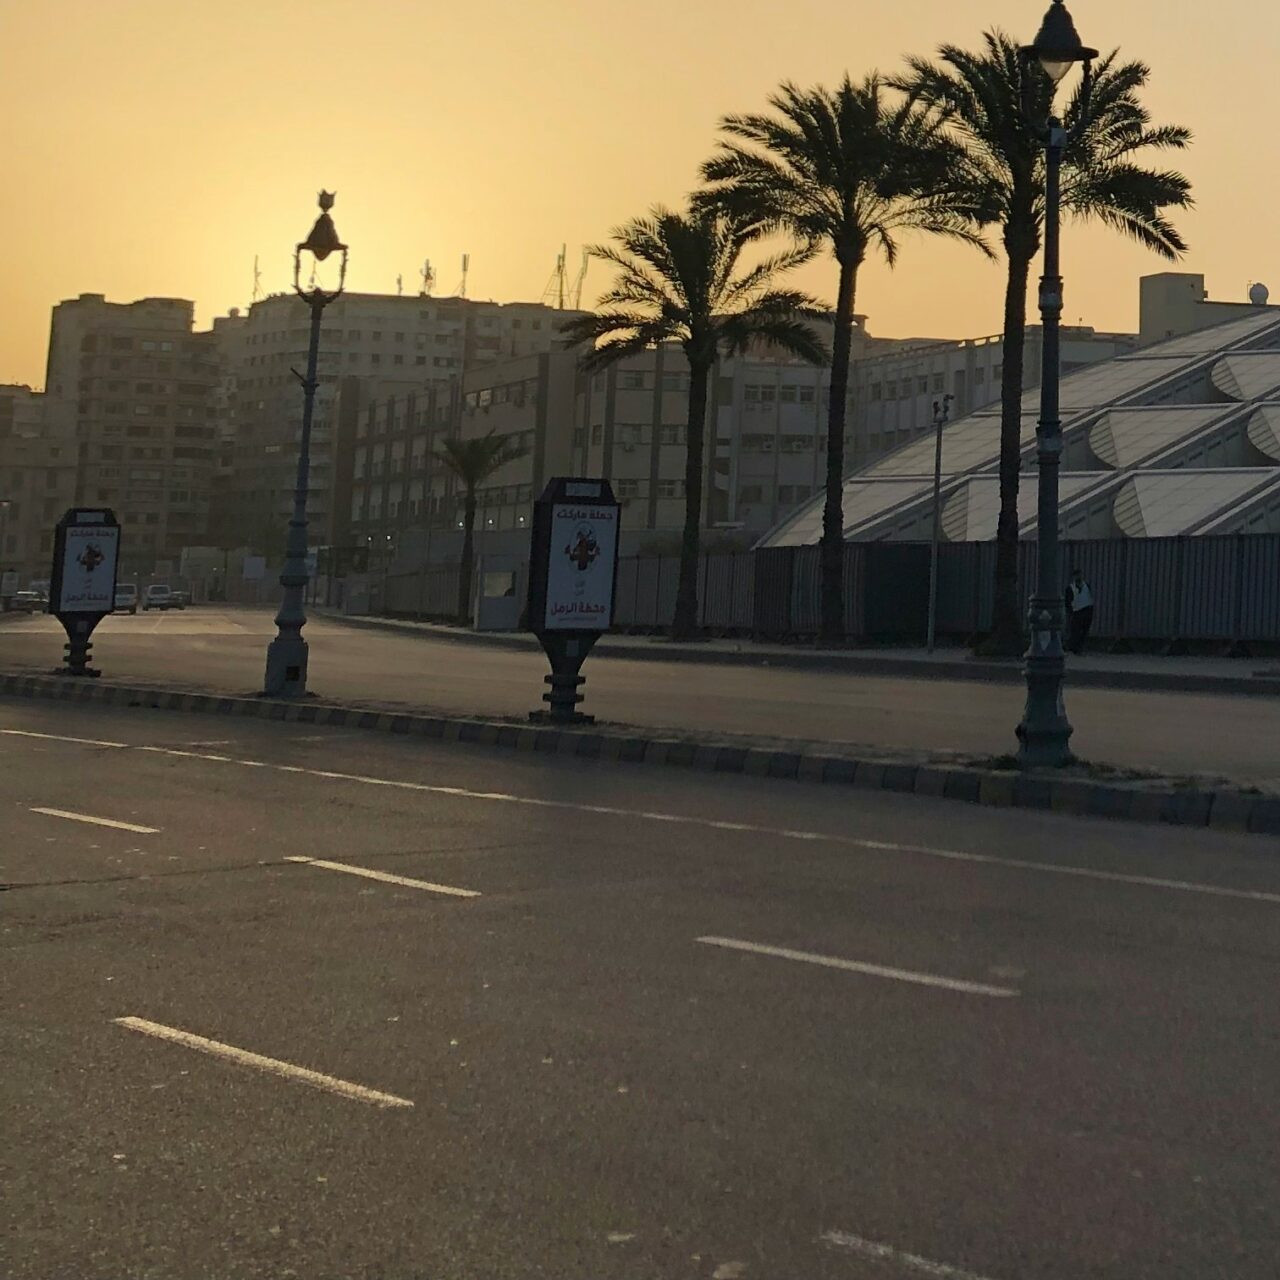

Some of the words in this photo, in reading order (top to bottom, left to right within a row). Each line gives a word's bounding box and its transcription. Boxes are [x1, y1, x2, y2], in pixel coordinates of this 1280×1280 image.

[556, 509, 587, 521] ماركت
[551, 602, 577, 616] الرمل
[578, 602, 606, 613] محطة
